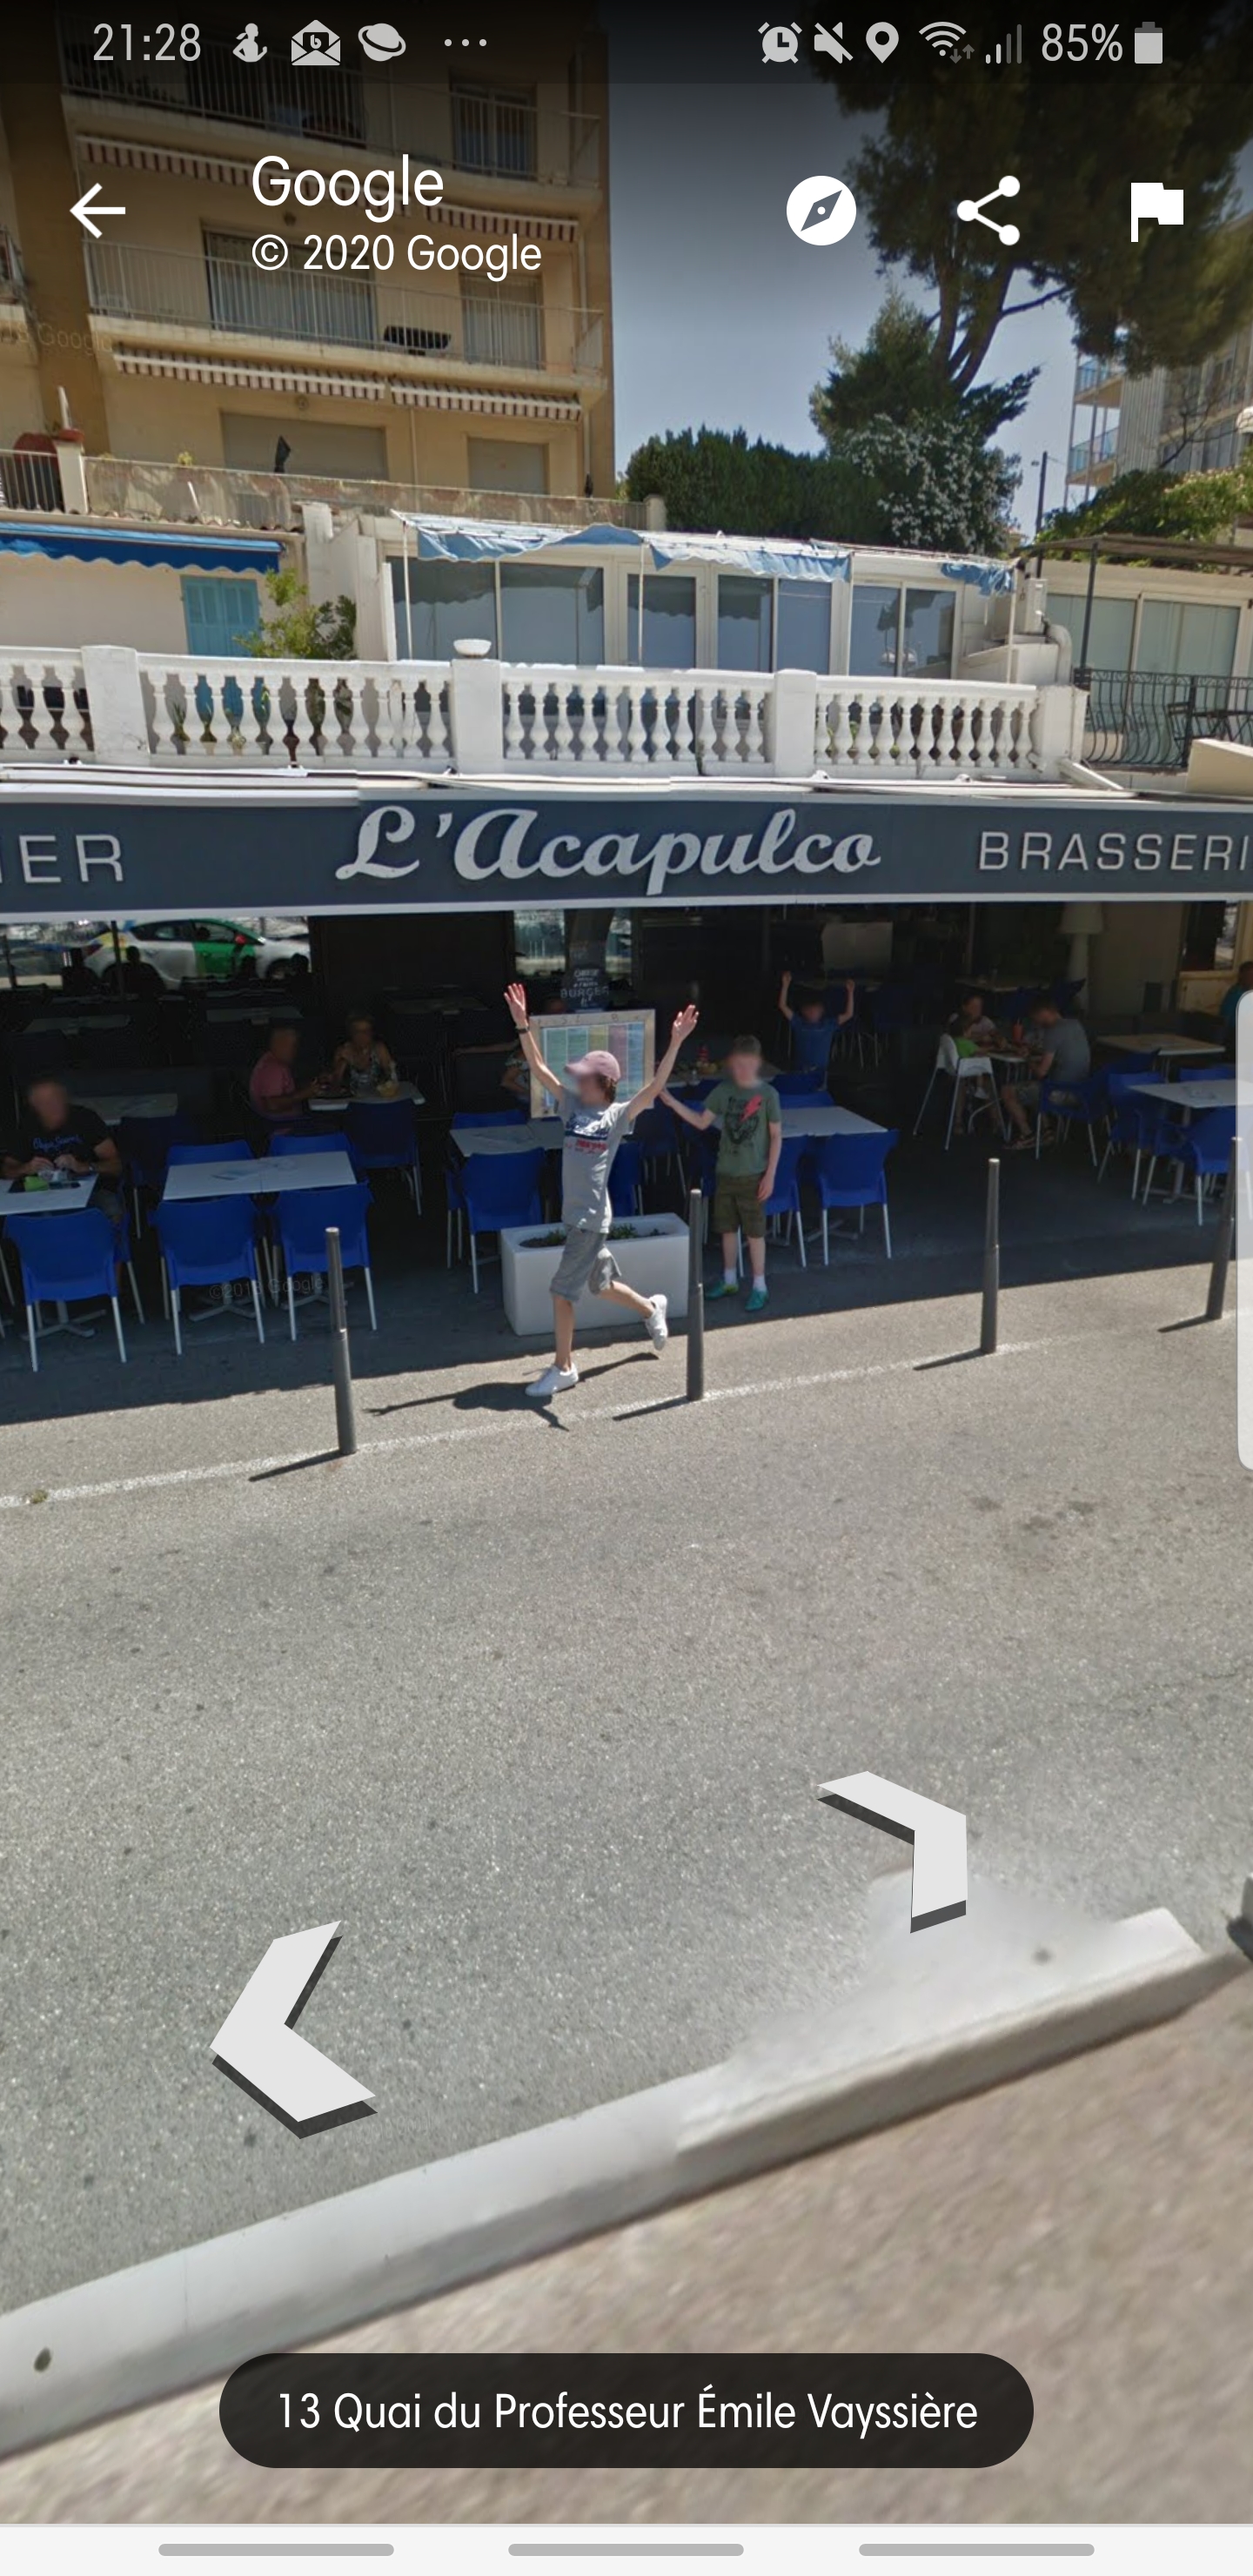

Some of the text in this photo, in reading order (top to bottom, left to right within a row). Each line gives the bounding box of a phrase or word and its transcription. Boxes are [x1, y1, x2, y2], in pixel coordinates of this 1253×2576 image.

[0, 834, 123, 883] ER
[335, 804, 882, 896] L'Acapulco
[979, 830, 1250, 871] BRASSERI
